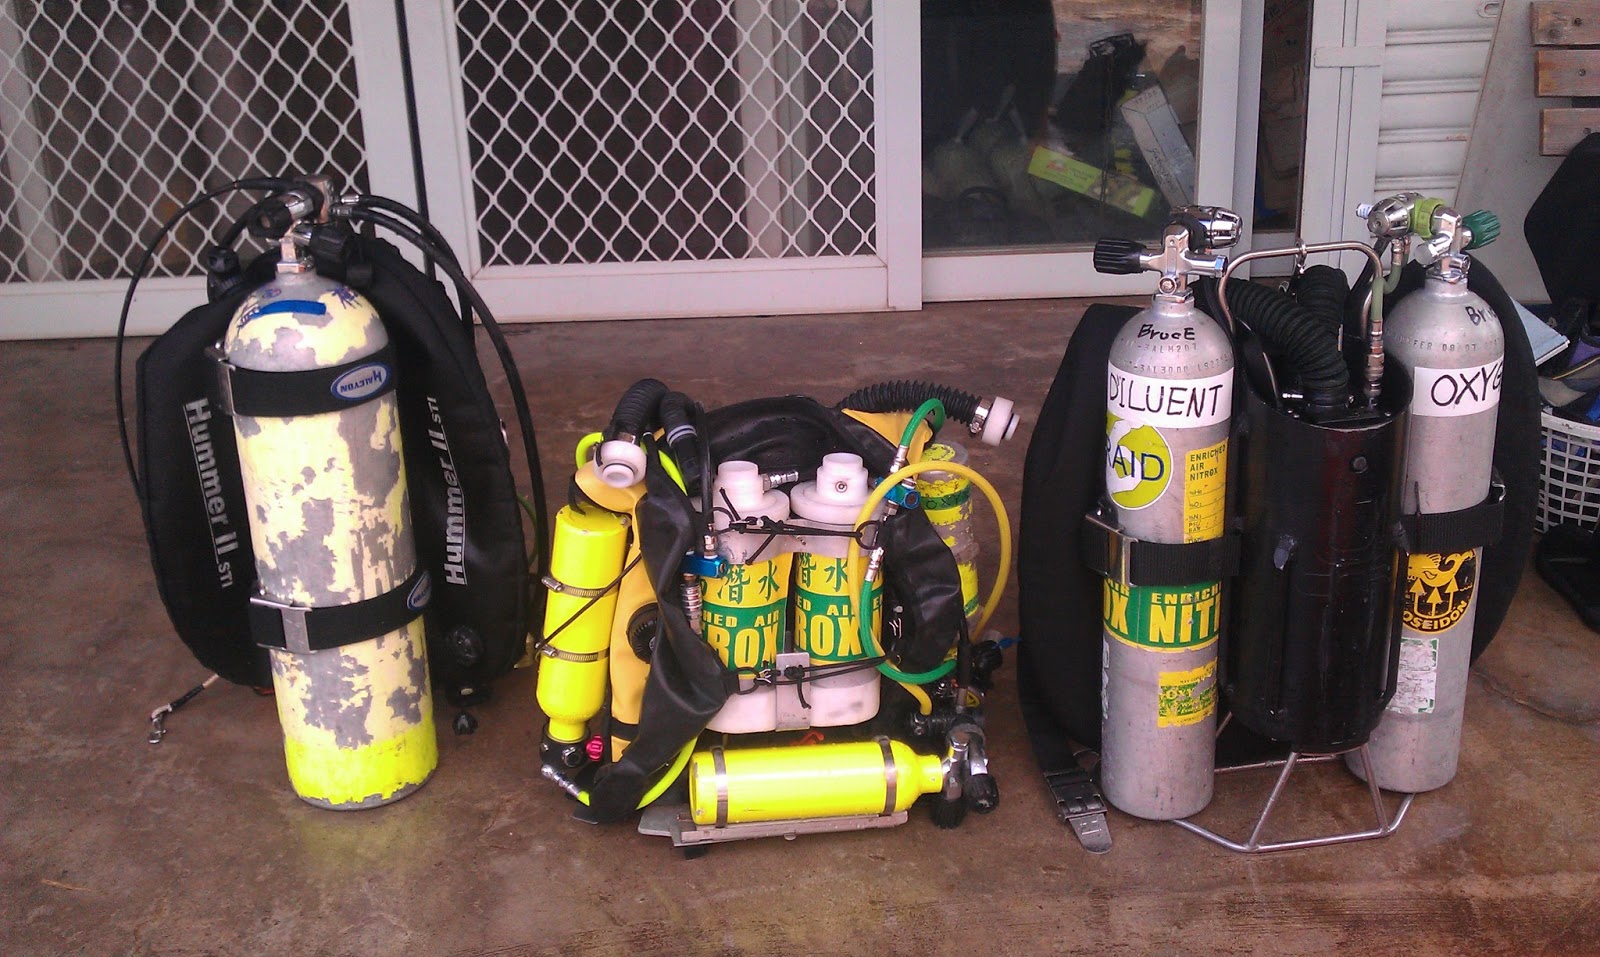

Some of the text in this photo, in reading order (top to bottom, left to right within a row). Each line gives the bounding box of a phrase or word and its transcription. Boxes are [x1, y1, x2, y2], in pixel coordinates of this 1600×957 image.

[340, 370, 383, 393] HALCYON
[1109, 372, 1224, 418] DILUENT
[185, 398, 229, 526] Hummer
[1189, 444, 1227, 462] ENRICHED
[1189, 462, 1205, 472] AIR
[1189, 467, 1219, 481] NITROX
[439, 456, 467, 586] Hummer
[1151, 581, 1221, 605] ENRICH
[703, 609, 738, 628] HED
[827, 604, 855, 616] AI
[1402, 600, 1467, 630] OSEIDON
[707, 621, 779, 669] ROX
[795, 609, 862, 657] ROX
